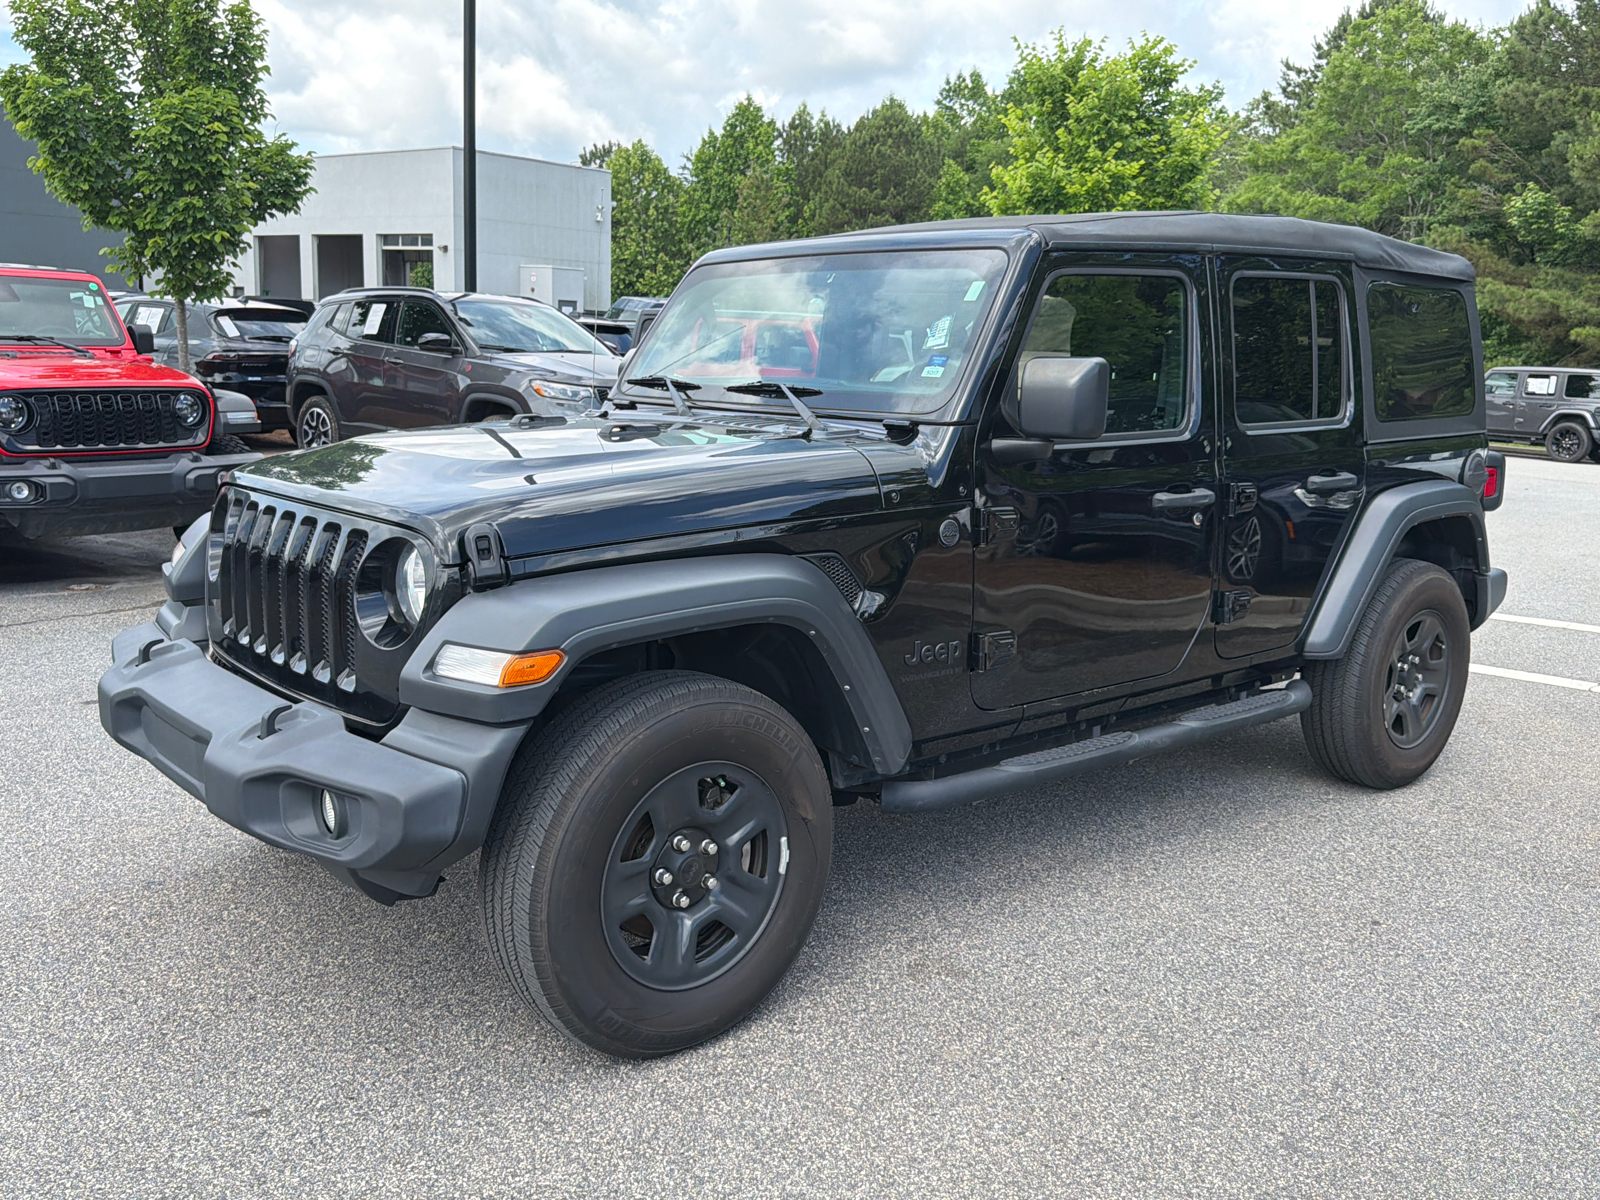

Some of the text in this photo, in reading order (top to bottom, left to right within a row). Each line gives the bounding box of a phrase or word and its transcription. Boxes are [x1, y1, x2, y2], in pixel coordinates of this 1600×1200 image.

[904, 640, 960, 666] Jeep
[900, 668, 954, 682] WRANGLER
[717, 711, 800, 754] MICHELIN
